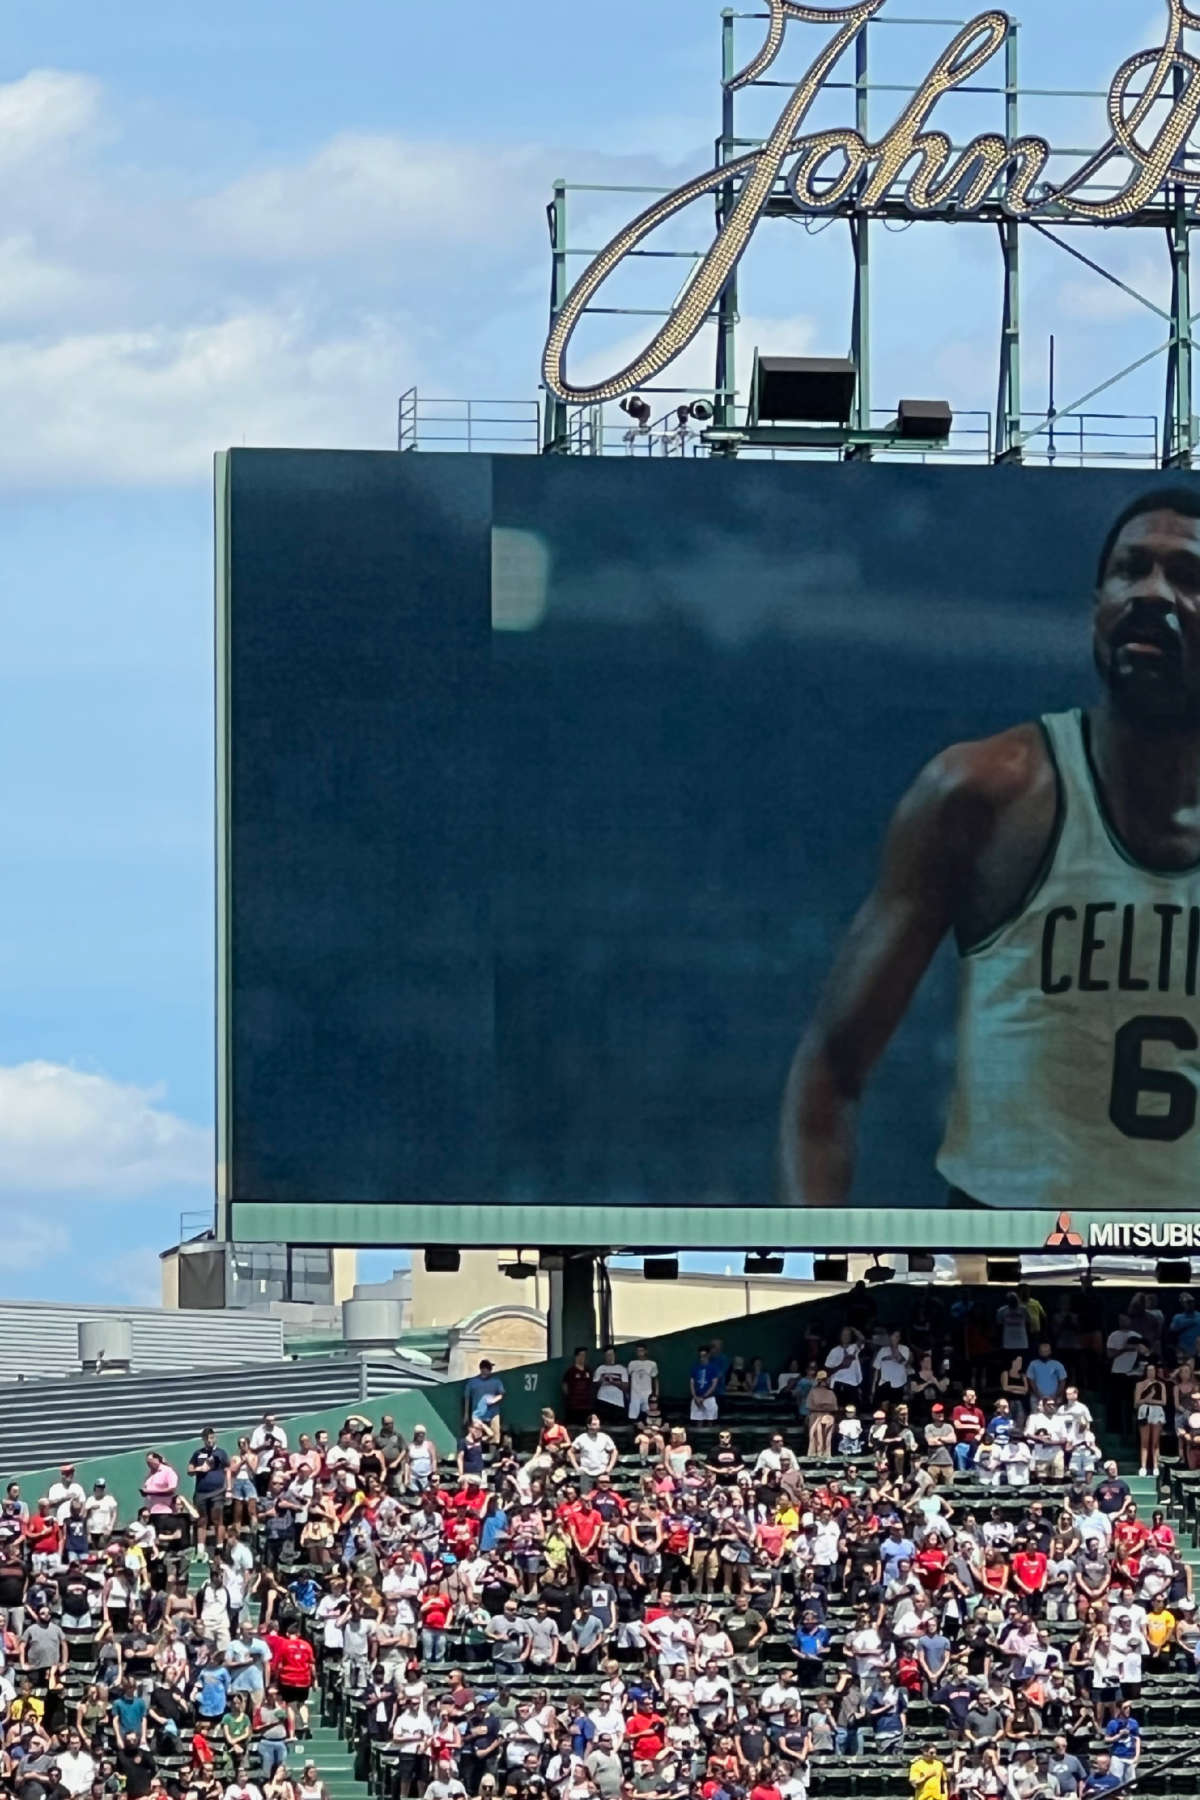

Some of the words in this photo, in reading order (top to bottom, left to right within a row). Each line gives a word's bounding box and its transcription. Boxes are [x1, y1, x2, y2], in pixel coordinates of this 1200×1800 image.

[542, 0, 1048, 405] John
[1109, 1015, 1198, 1142] 6
[524, 1373, 539, 1392] 37
